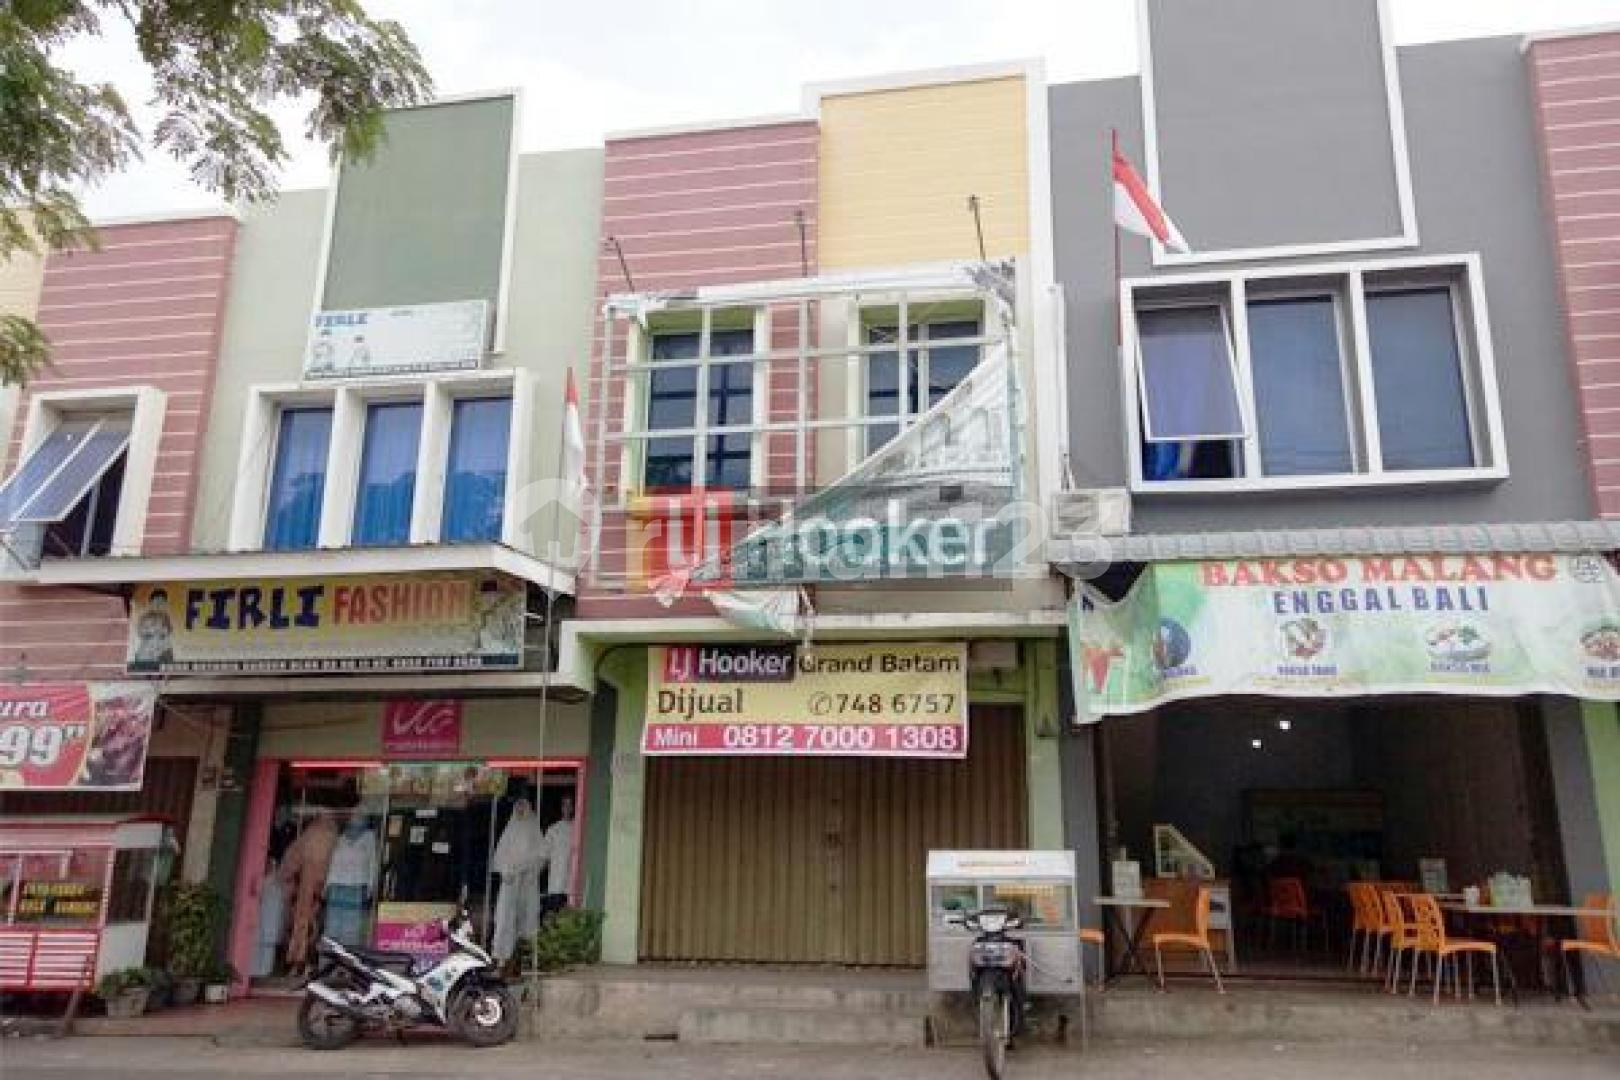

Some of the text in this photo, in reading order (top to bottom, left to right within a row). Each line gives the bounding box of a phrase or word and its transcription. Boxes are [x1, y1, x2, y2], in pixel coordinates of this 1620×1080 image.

[1202, 558, 1348, 586] BAKSO
[1362, 552, 1557, 583] MALANG
[184, 581, 473, 630] FIRLI FASHION
[1273, 586, 1489, 614] ENGGAL BALI
[699, 648, 792, 674] Hooker
[798, 652, 960, 673] Grand Batam
[657, 688, 956, 720] Dijual 748 6757
[655, 725, 958, 750] Mini 0812 7000 1308
